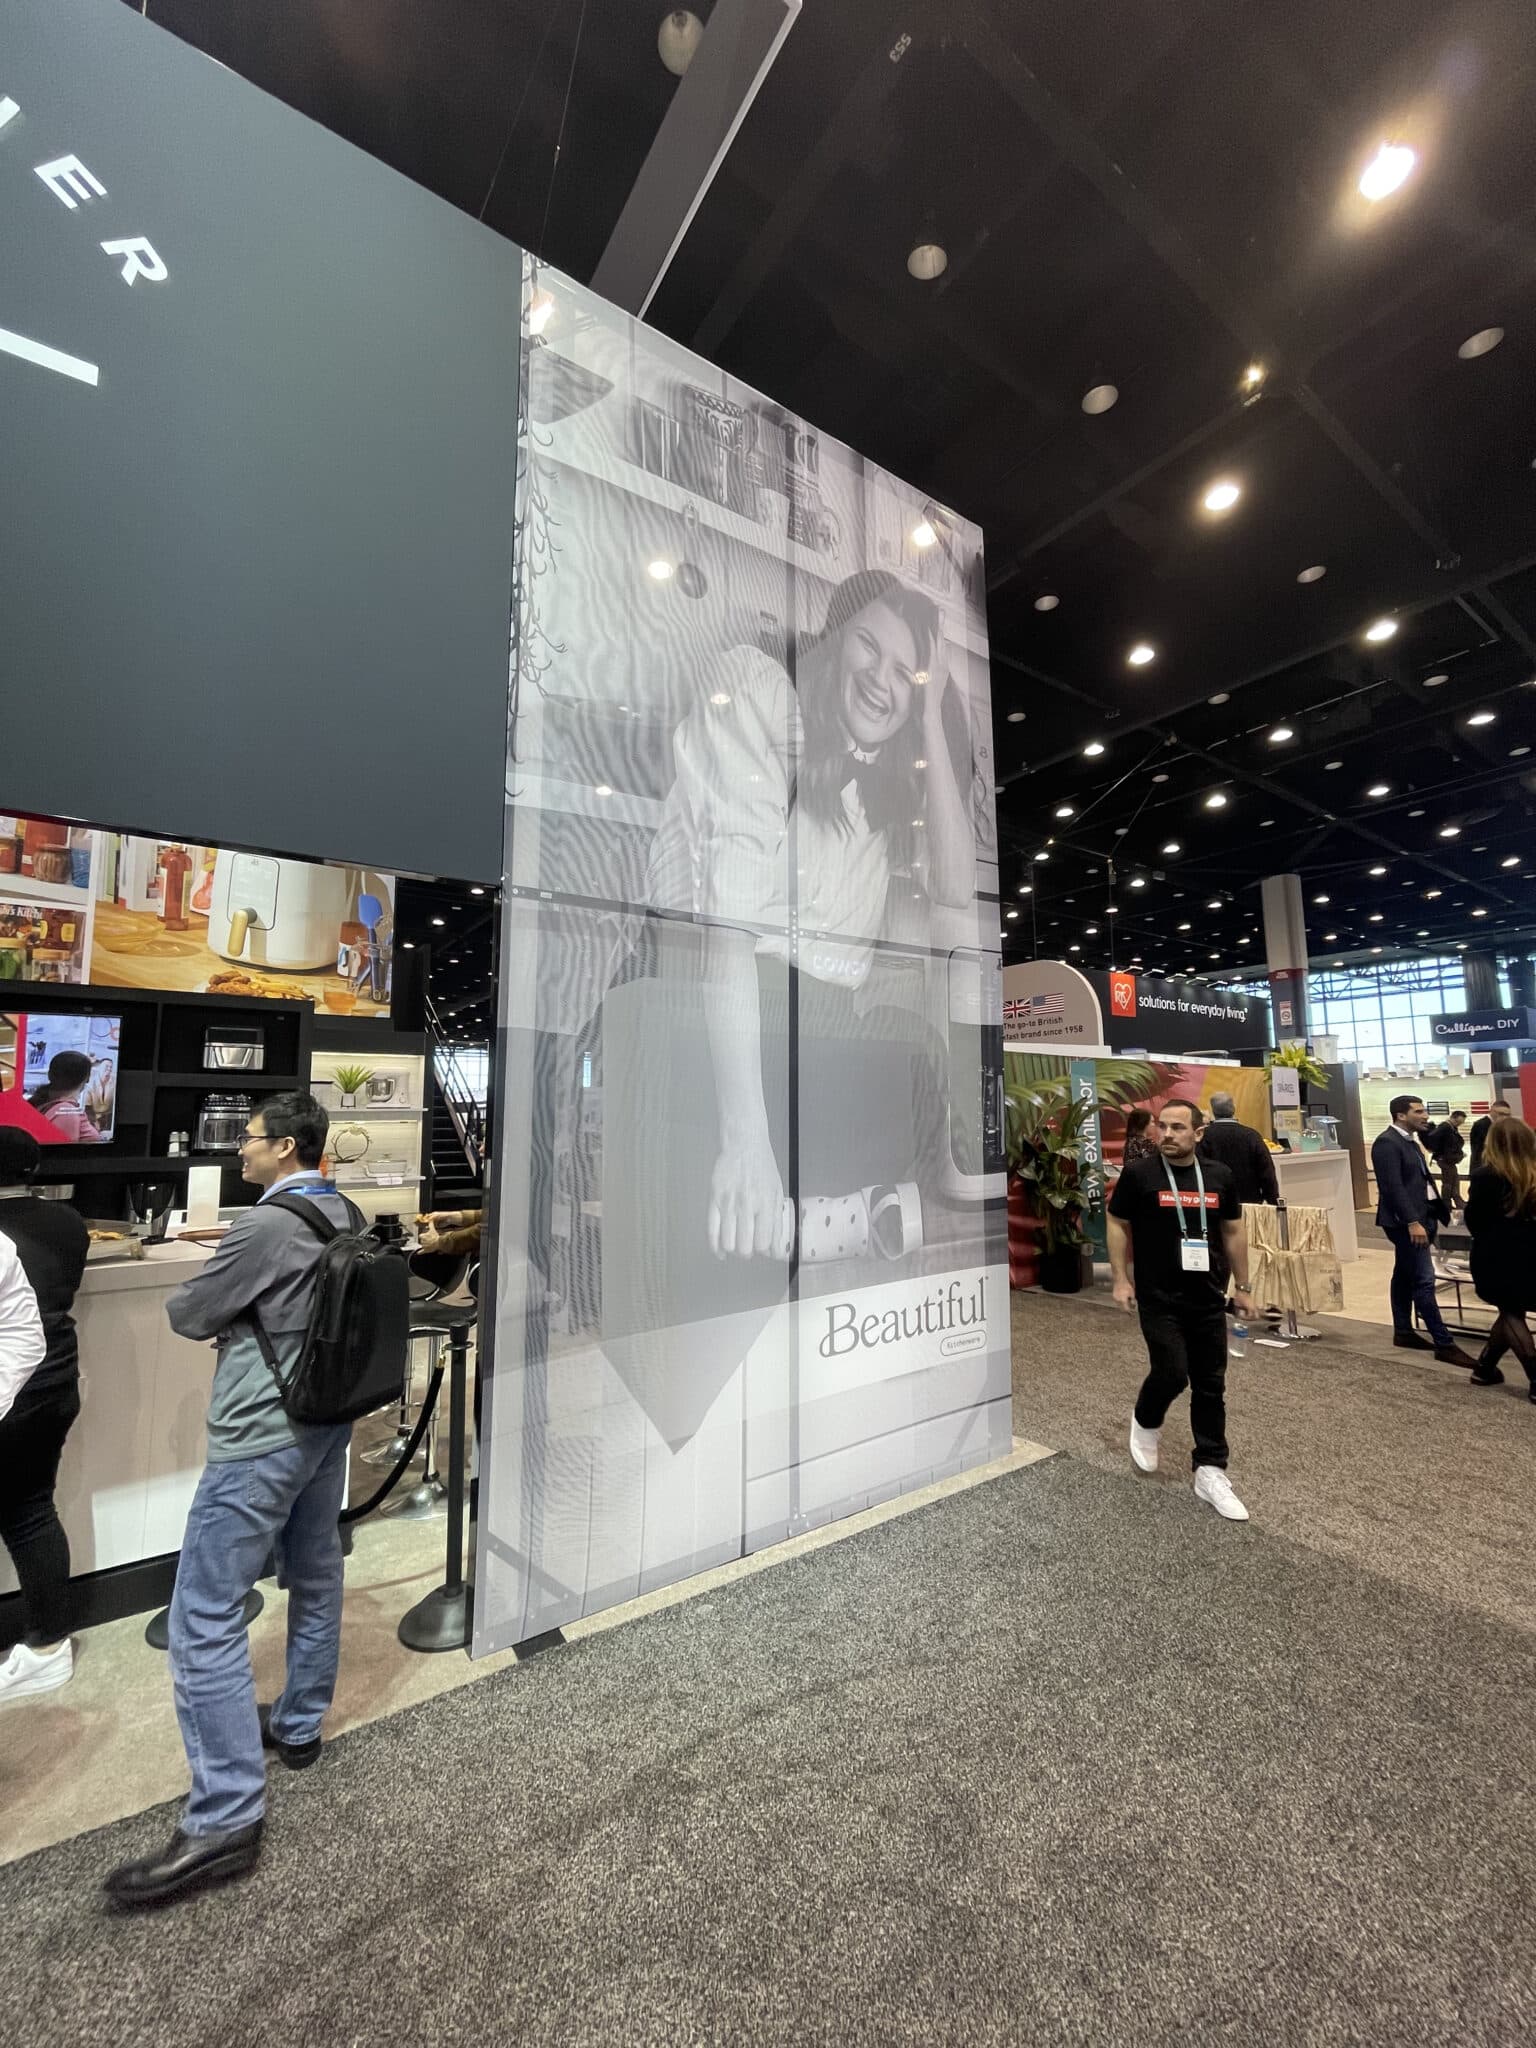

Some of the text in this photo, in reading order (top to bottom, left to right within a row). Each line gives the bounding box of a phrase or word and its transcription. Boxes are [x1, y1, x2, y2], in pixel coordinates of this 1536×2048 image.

[1138, 995, 1177, 1011] solutions
[1178, 999, 1190, 1012] for
[1191, 1004, 1226, 1019] everyday
[1004, 1017, 1064, 1030] The go-to British
[1020, 1031, 1042, 1039] brand
[1043, 1028, 1063, 1036] since
[1065, 1025, 1084, 1033] 1958
[1435, 1018, 1520, 1036] Culligan DIY
[819, 1276, 988, 1358] Beautiful
